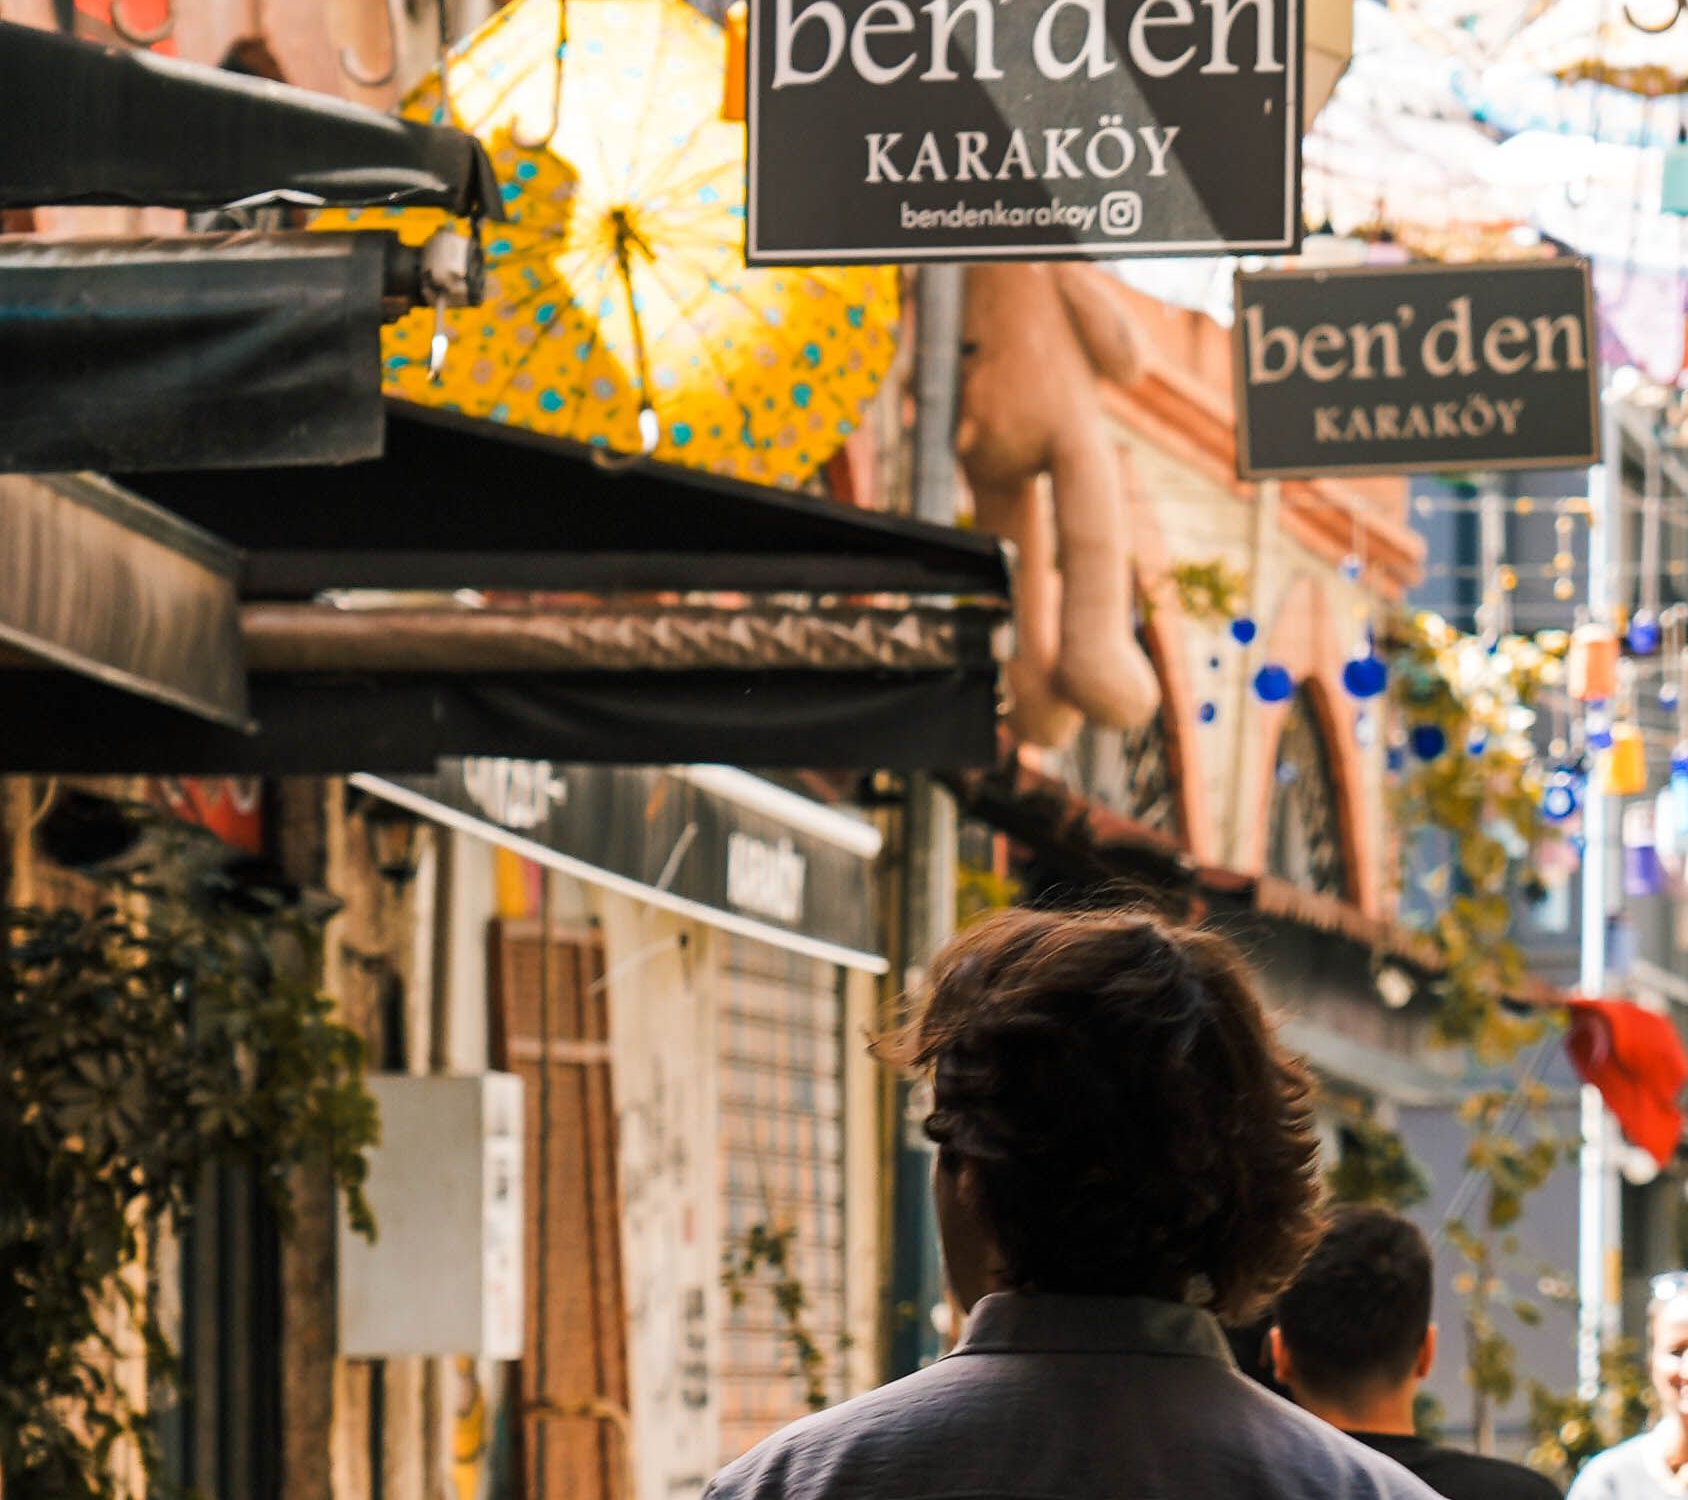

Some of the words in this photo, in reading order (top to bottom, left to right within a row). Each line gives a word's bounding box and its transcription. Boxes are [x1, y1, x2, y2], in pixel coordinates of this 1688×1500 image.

[864, 115, 1181, 184] KARAKÖY
[900, 197, 1097, 232] bendenkarakoy
[1313, 393, 1525, 442] KARAKÖY
